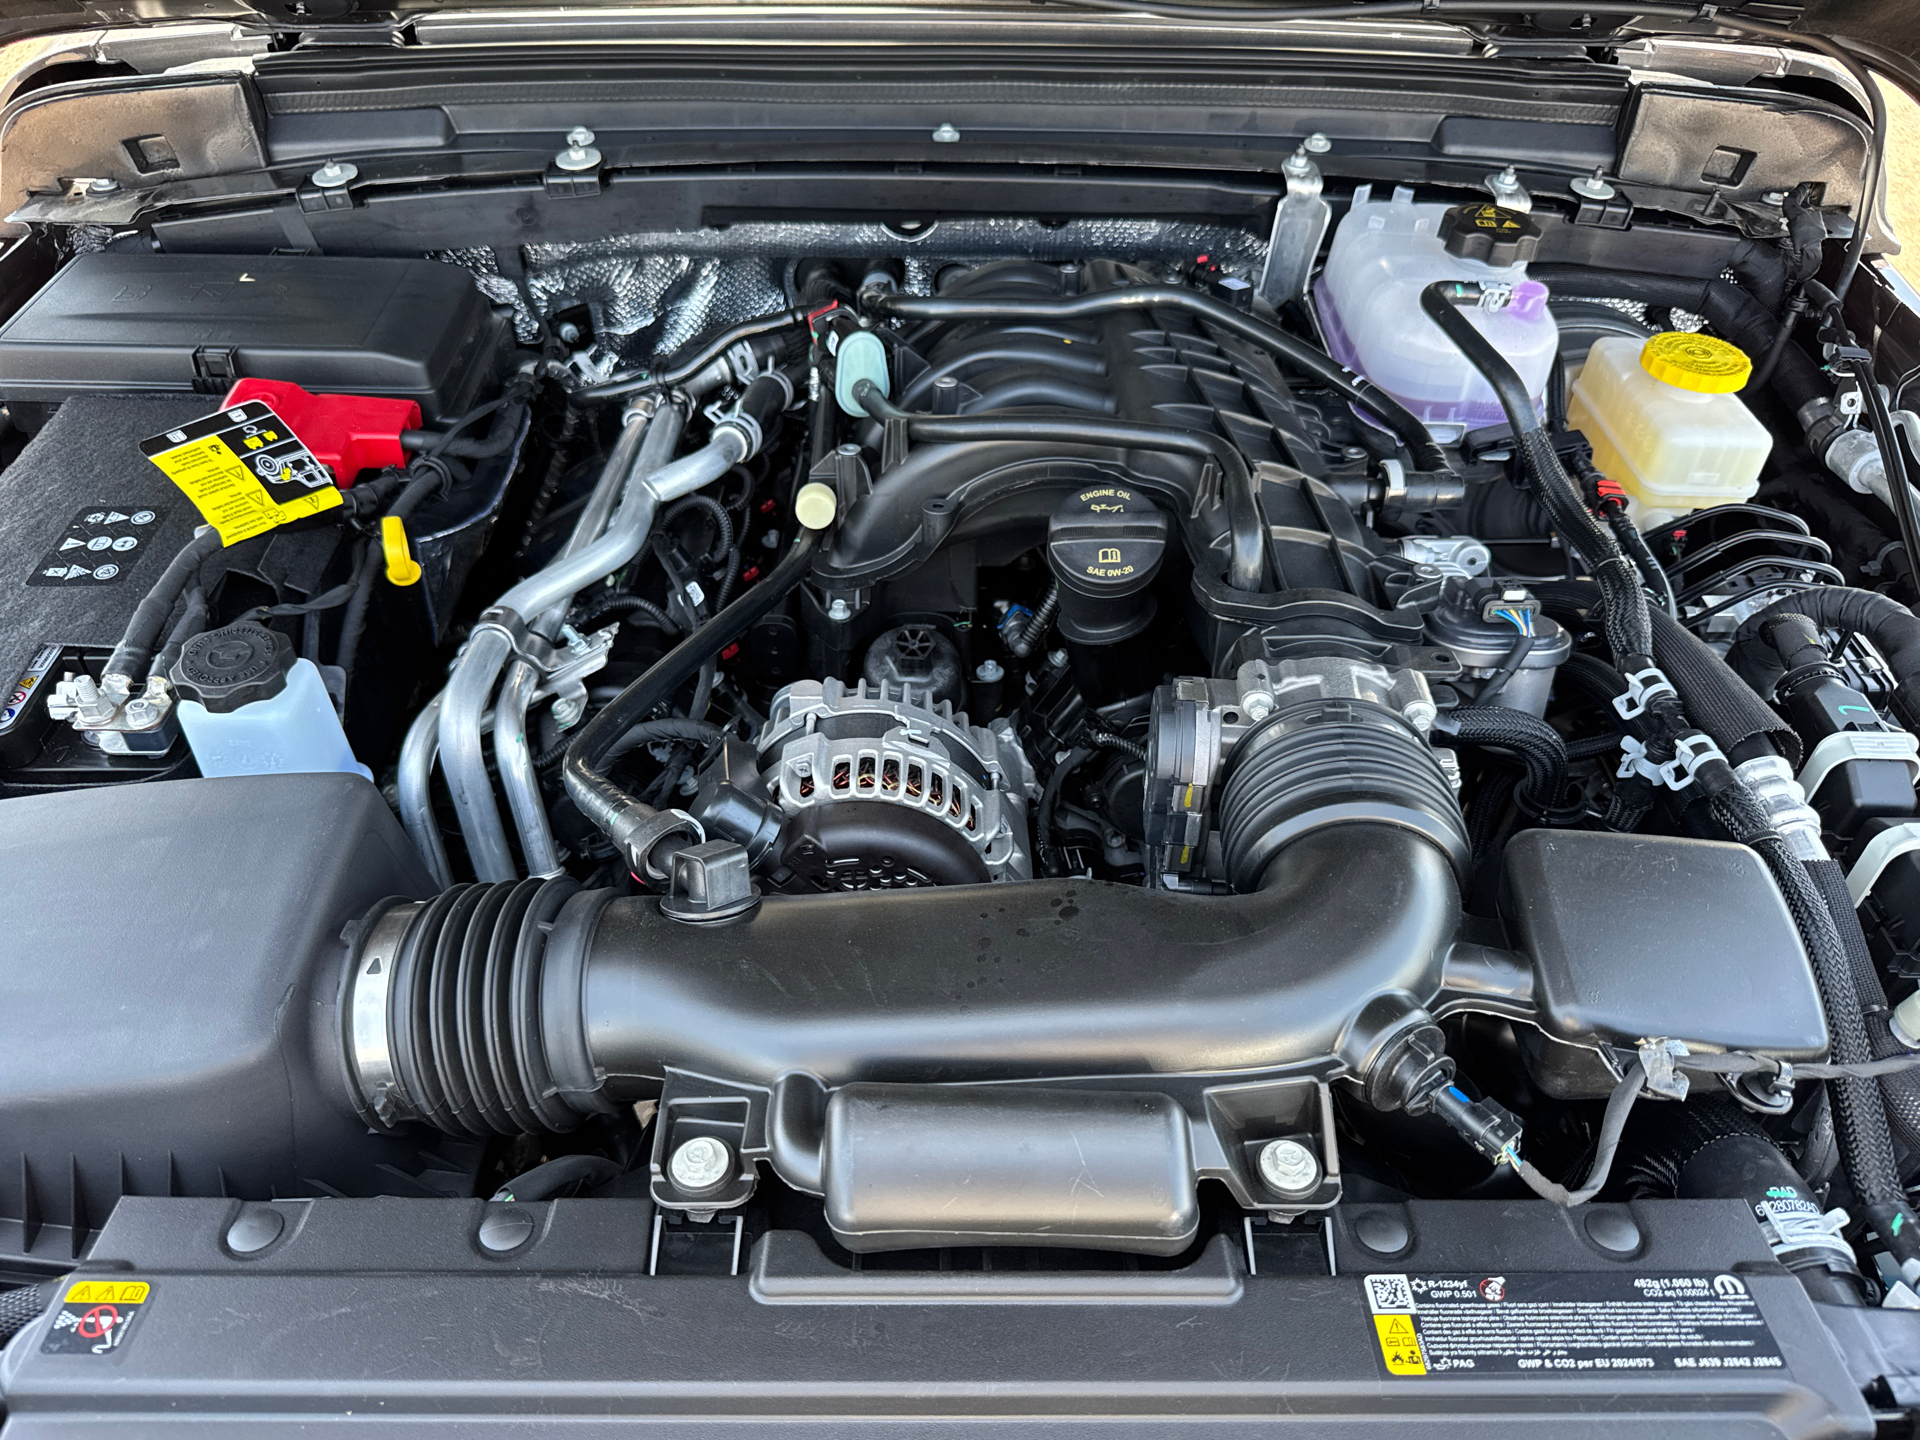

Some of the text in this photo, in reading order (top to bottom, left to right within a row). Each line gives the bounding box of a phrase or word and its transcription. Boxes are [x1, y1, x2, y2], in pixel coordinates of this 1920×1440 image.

[1080, 489, 1131, 501] ENGINE OIL
[1086, 565, 1134, 577] SAE 0W-20
[188, 636, 209, 656] FLUID
[187, 666, 235, 683] APPROVED
[1755, 1200, 1820, 1216] 6280782AD
[1634, 1278, 1660, 1289] 482g
[1431, 1290, 1477, 1298] GWP 0.501
[1643, 1289, 1663, 1297] CO2
[1664, 1290, 1676, 1298] eq
[1453, 1359, 1475, 1368] PAG
[1518, 1359, 1542, 1368] GWP
[1544, 1359, 1553, 1368] &
[1554, 1359, 1576, 1368] CO2
[1577, 1360, 1593, 1369] per
[1595, 1358, 1610, 1368] EU
[1674, 1357, 1697, 1367] SAE
